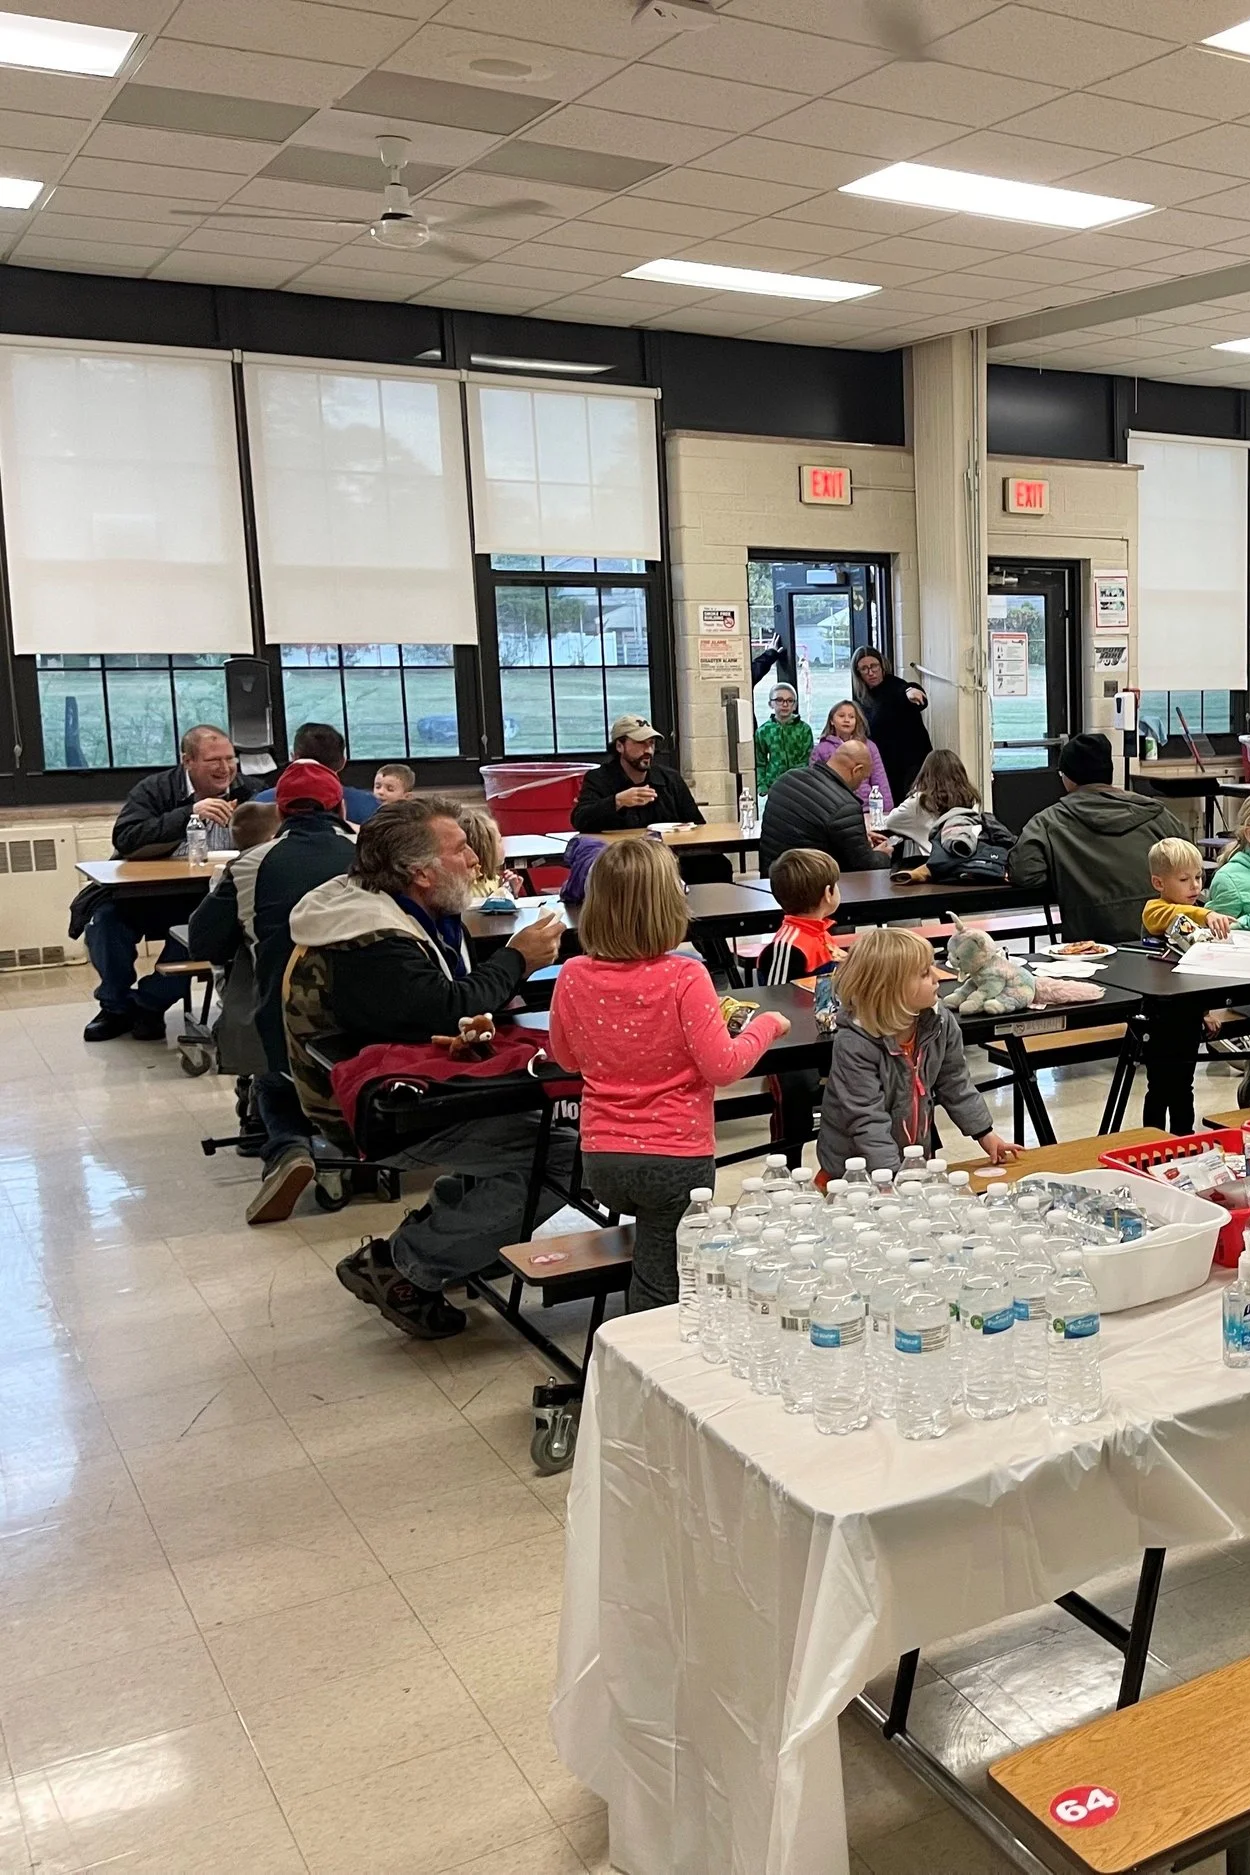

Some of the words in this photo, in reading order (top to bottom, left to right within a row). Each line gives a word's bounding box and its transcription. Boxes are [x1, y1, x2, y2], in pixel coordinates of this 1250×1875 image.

[812, 470, 843, 498] EXIT
[1016, 482, 1044, 508] EXIT
[1056, 1788, 1115, 1822] 64
